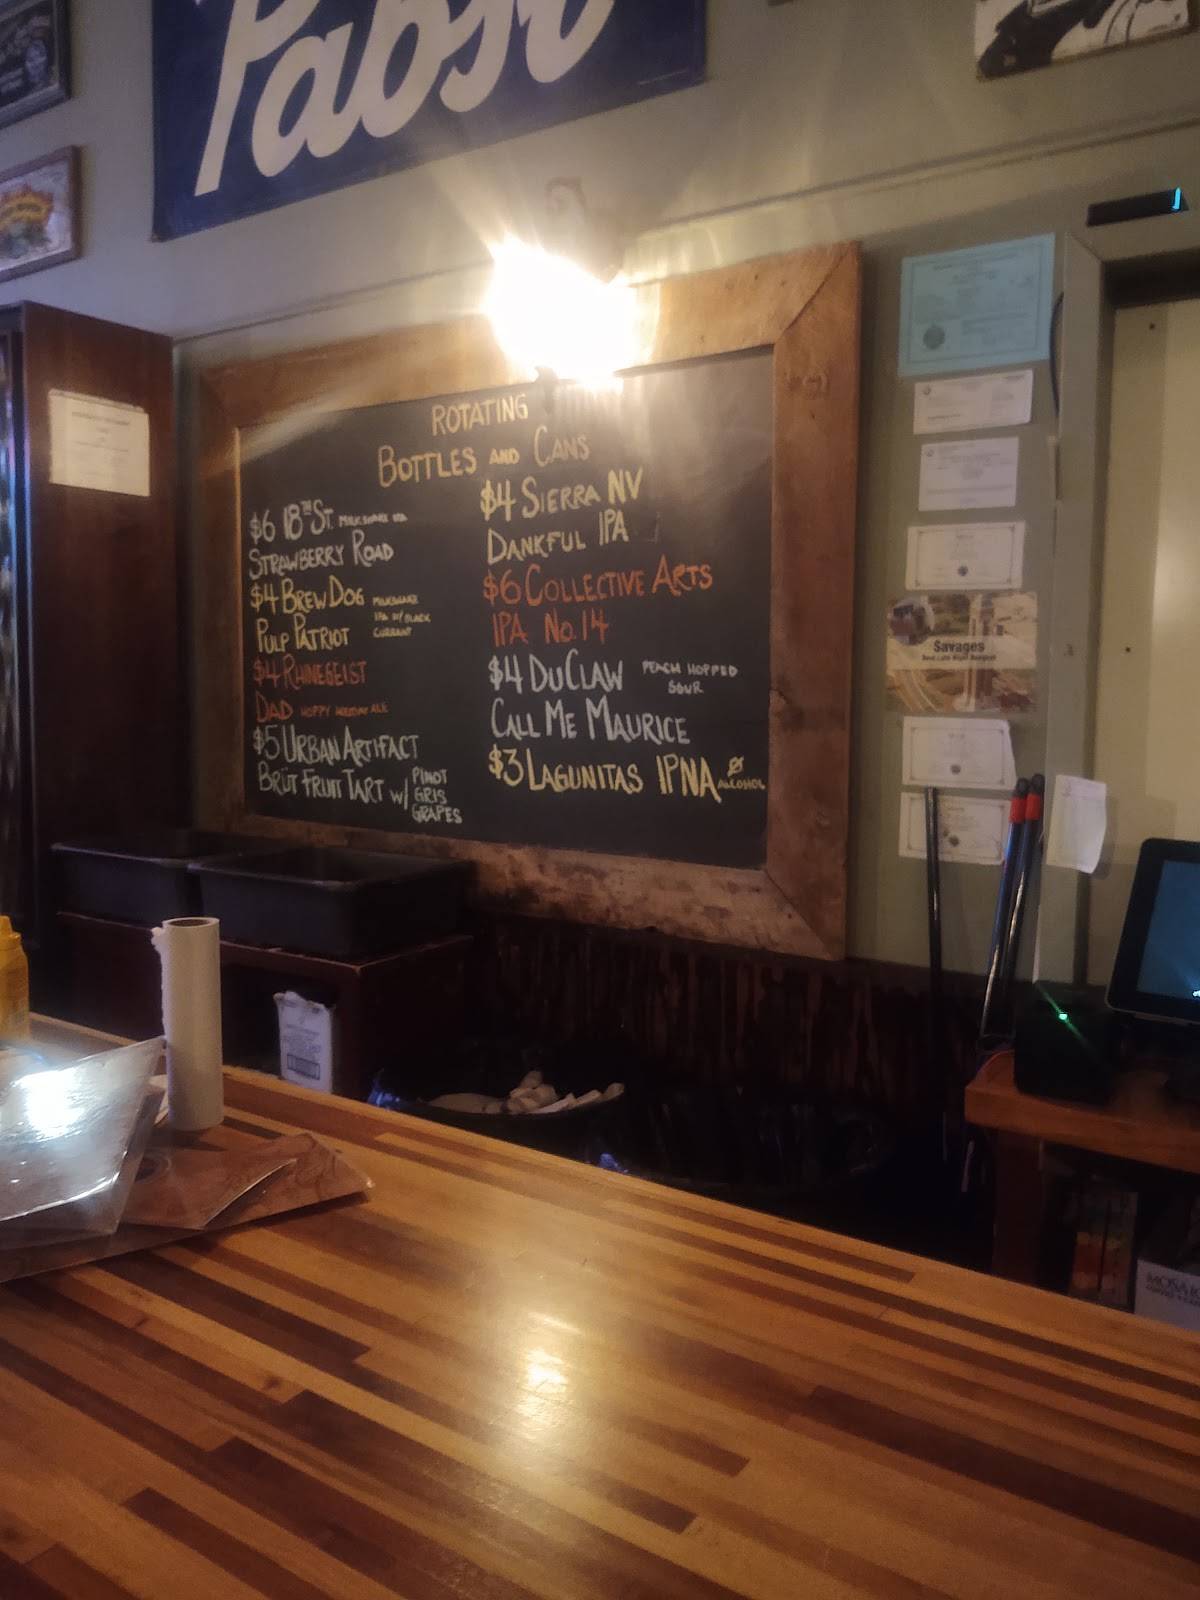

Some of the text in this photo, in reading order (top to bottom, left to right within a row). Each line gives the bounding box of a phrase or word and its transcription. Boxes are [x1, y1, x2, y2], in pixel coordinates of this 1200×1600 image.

[431, 394, 529, 437] ROTATING
[378, 425, 591, 488] BOTTLES AND CANS
[480, 466, 643, 522] $4 SIERRA NV
[250, 509, 276, 545] $6
[487, 509, 629, 565] DANKFUL IPA
[249, 529, 394, 580] STRAWBERRY ROAD
[250, 583, 279, 616] $4
[483, 554, 713, 606] $6 COLLECTIVE ARTS
[256, 611, 350, 654] PULP PATRIOT
[492, 611, 528, 647] IPA
[582, 607, 609, 644] 14
[934, 640, 985, 654] Savages
[253, 657, 281, 688] $4
[488, 655, 523, 694] $4
[642, 661, 738, 677] PEACH HOPPED
[668, 680, 703, 695] SOUR
[255, 690, 294, 723] DAD
[491, 695, 690, 744] CALL ME MAURICE
[254, 724, 419, 767] $5 URBAN ARTIFACT
[302, 768, 341, 800] FRUIT
[342, 769, 384, 803] TART
[412, 766, 447, 785] PINOT
[488, 744, 722, 803] $3 LAGUNITAS IPNA
[412, 805, 463, 824] GRAPES
[414, 787, 447, 804] GRIS
